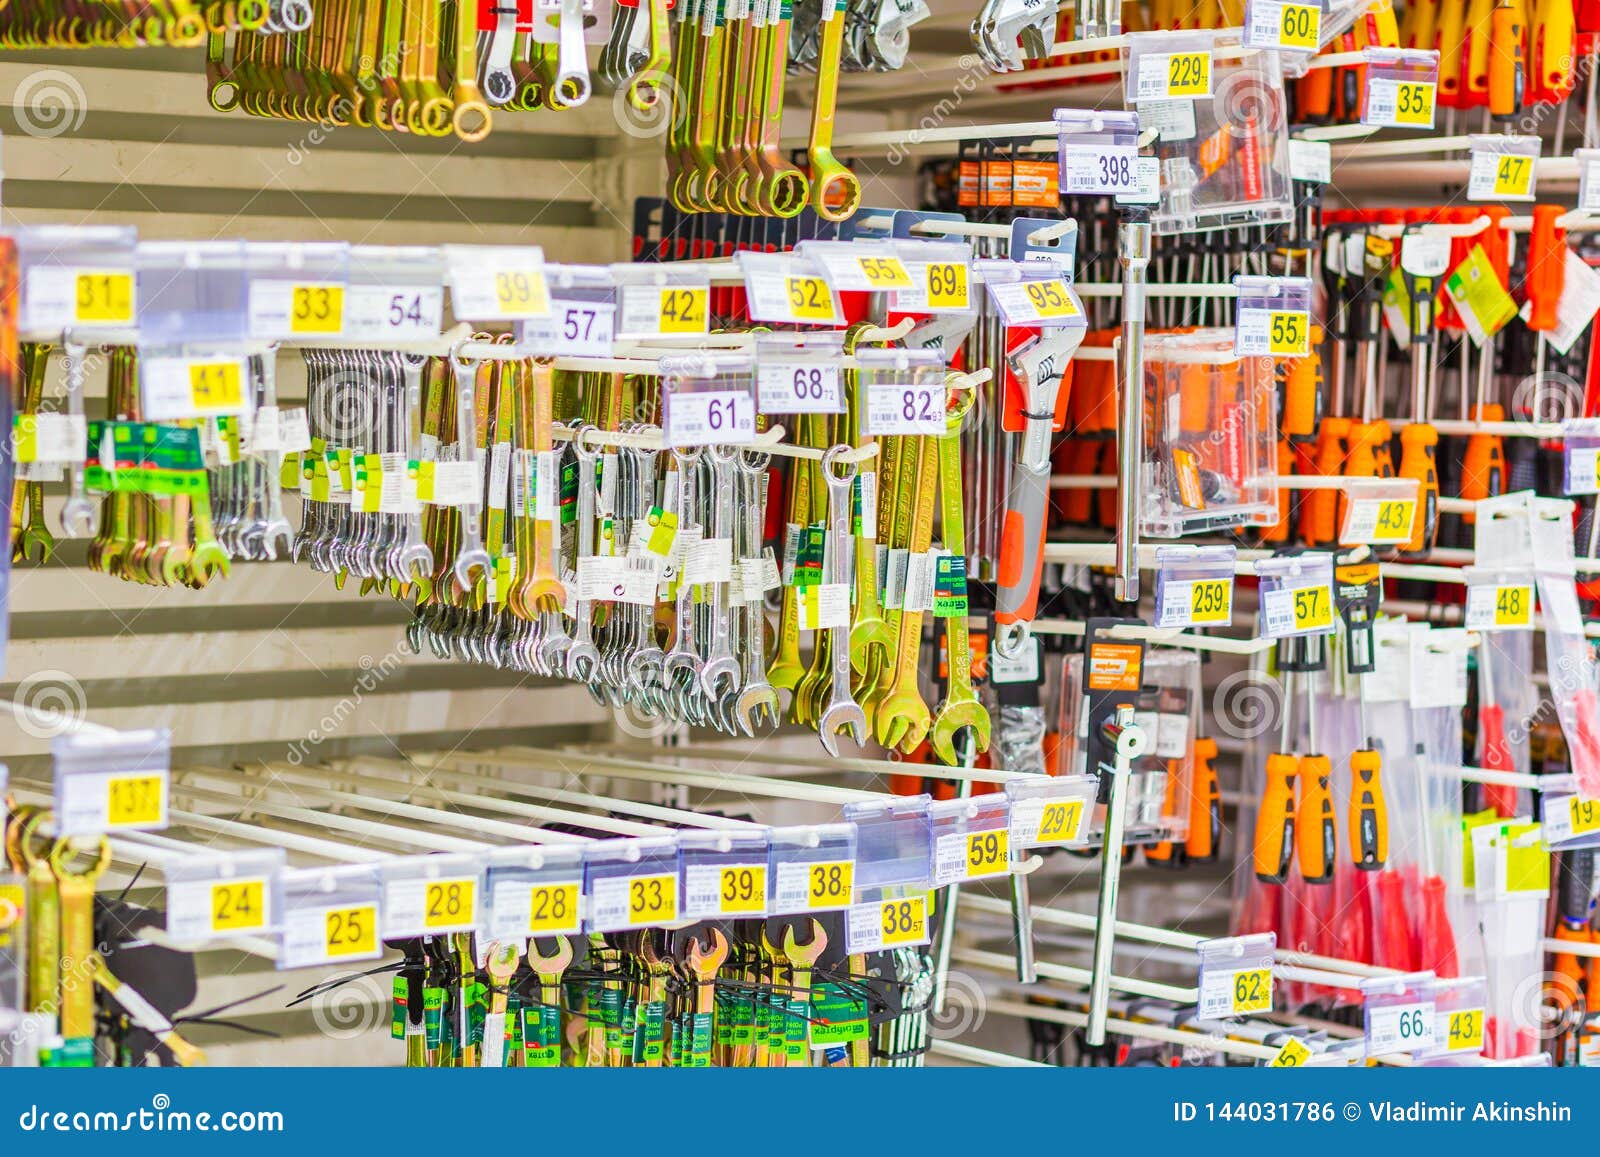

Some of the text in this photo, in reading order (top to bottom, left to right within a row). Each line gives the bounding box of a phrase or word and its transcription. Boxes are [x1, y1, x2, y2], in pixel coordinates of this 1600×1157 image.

[1284, 7, 1309, 38] 60
[1170, 57, 1201, 87] 229
[1399, 86, 1423, 113] 35
[1099, 156, 1129, 187] 398
[1499, 159, 1523, 184] 47
[859, 258, 895, 280] 55
[930, 265, 956, 296] 69
[77, 275, 113, 308] 31
[496, 272, 530, 302] 39
[789, 279, 821, 308] 52
[1027, 280, 1062, 309] 95
[296, 288, 331, 320] 33
[389, 295, 422, 325] 54
[662, 291, 694, 321] 42
[565, 310, 596, 340] 57
[1272, 316, 1297, 344] 55
[193, 366, 227, 398] 41
[794, 368, 823, 399] 68
[708, 399, 736, 430] 61
[903, 390, 931, 421] 82
[1378, 503, 1404, 529] 43
[1194, 583, 1223, 613] 259
[1295, 590, 1319, 620] 57
[1497, 589, 1520, 615] 48
[1041, 805, 1075, 835] 291
[1571, 800, 1592, 825] 19
[970, 833, 998, 866] 59
[631, 880, 662, 912] 33
[723, 870, 753, 901] 39
[812, 865, 841, 897] 38
[217, 888, 250, 921] 24
[428, 884, 461, 917] 28
[534, 888, 566, 920] 28
[329, 912, 362, 945] 25
[884, 902, 923, 935] 38 57
[1235, 973, 1261, 1003] 62
[1400, 1010, 1424, 1038] 66
[1449, 1013, 1473, 1040] 43
